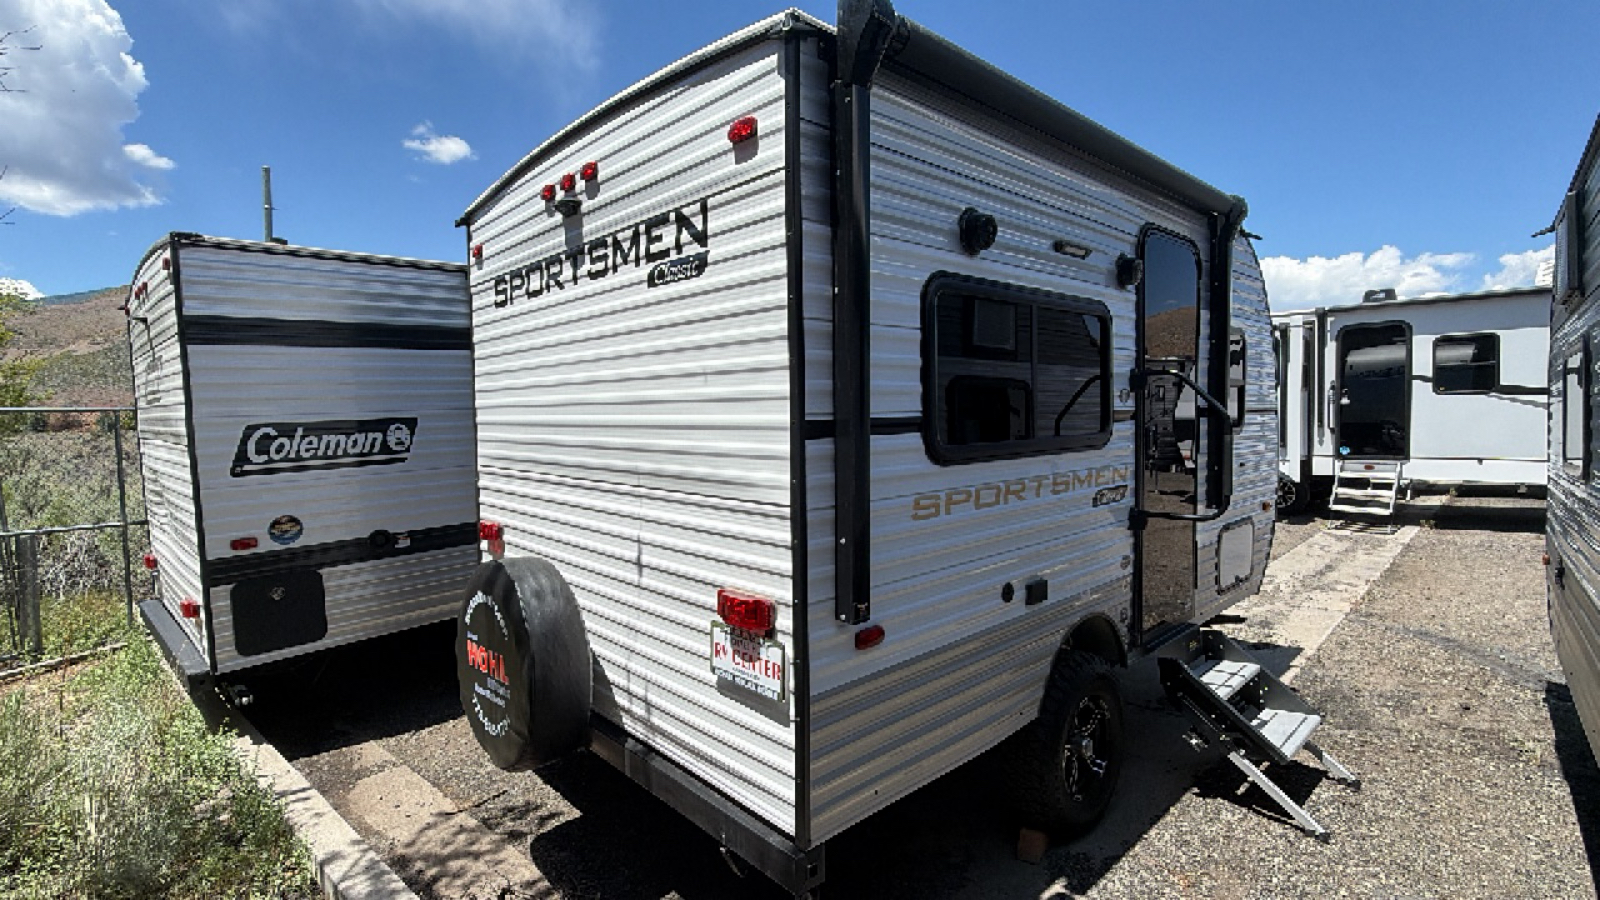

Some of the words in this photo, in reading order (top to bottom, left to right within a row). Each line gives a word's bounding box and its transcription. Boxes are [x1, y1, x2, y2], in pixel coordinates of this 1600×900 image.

[494, 199, 708, 308] SPORTSMEN
[654, 256, 700, 285] Classic
[247, 426, 384, 463] Coleman
[911, 465, 1129, 521] SPORTSMEN
[714, 642, 728, 659] RV
[732, 649, 781, 681] CENTER
